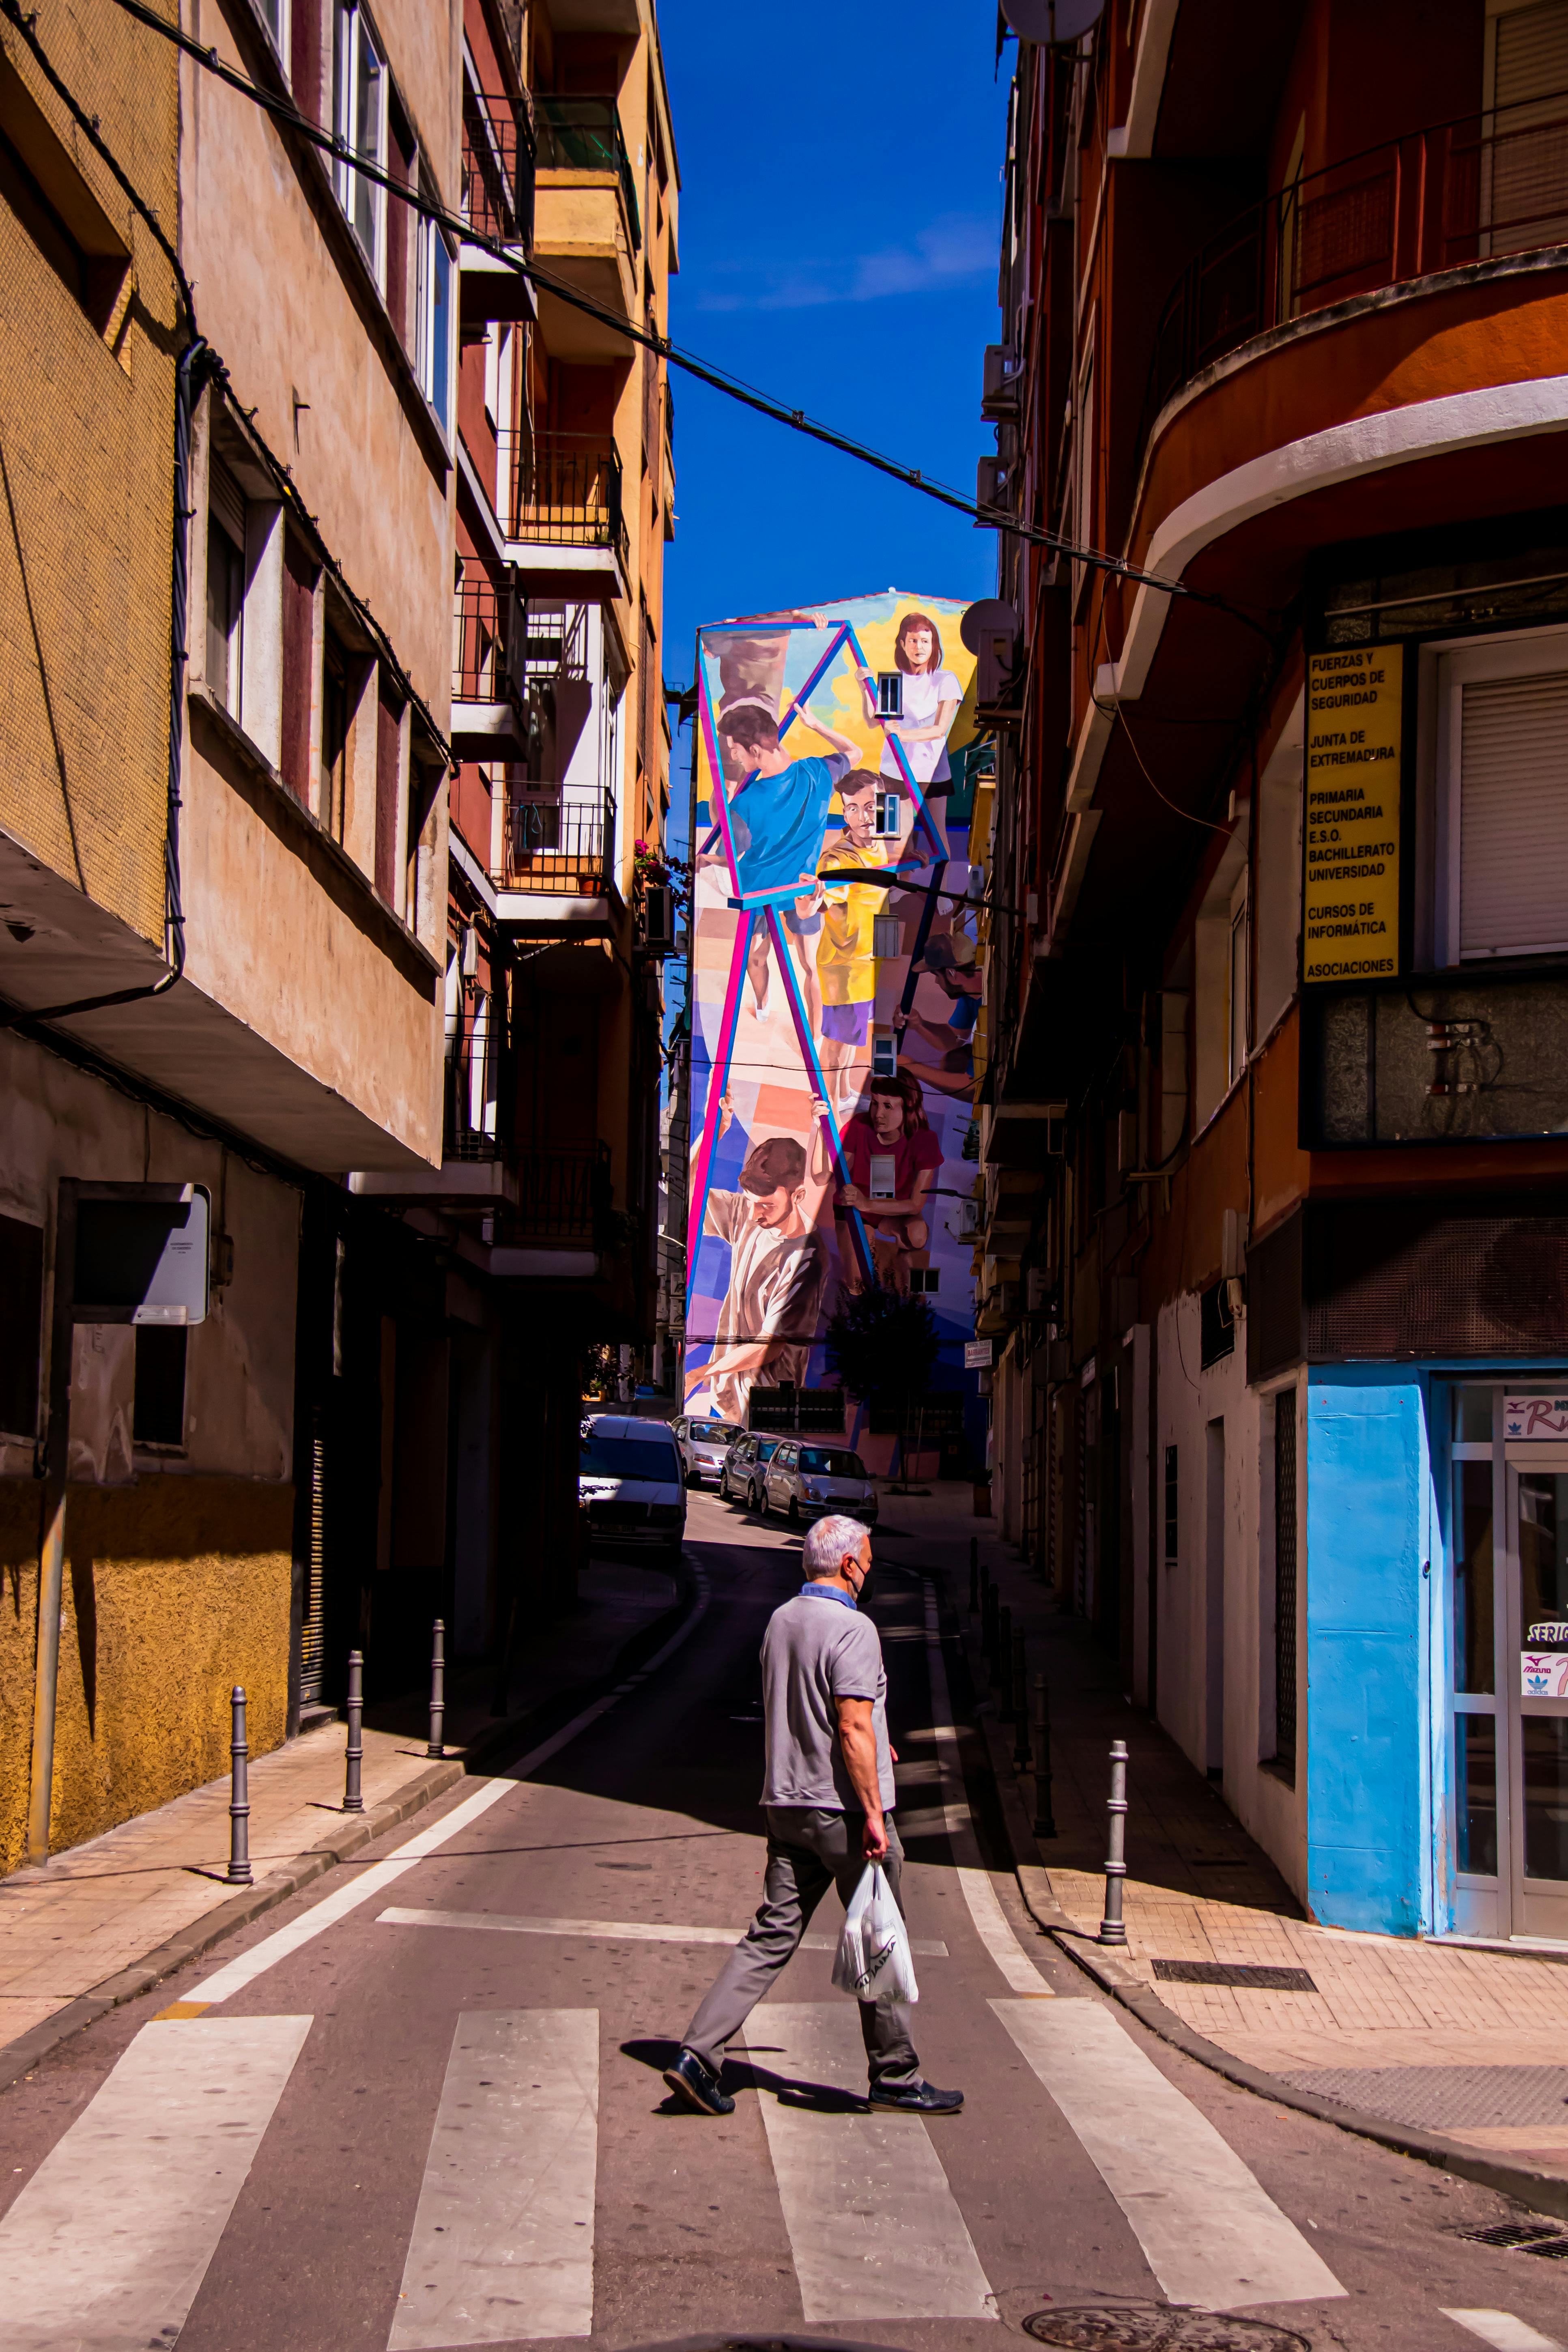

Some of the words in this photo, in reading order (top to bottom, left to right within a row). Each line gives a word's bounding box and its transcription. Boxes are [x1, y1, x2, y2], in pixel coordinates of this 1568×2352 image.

[1312, 654, 1363, 672] FUERZAS
[1366, 652, 1374, 665] Y
[1312, 673, 1366, 691] CUERPOS
[1370, 670, 1385, 684] DE
[1312, 690, 1377, 710] SEGURIDAD
[1310, 733, 1346, 748] JUNTA
[1350, 731, 1365, 744] DE
[1311, 746, 1395, 768] EXTREMADURA
[1310, 788, 1365, 805] PRIMARIA
[1310, 806, 1383, 825] SECUNDARIA
[1310, 829, 1341, 844] E.S.O.
[1309, 843, 1394, 863] BACHILLERATO
[1309, 863, 1385, 882] UNIVERSIDAD
[1308, 905, 1355, 920] CURSOS
[1359, 903, 1374, 916] DE
[1308, 920, 1386, 939] INFORMÁTICA
[1308, 959, 1394, 977] ASOCIACIONES
